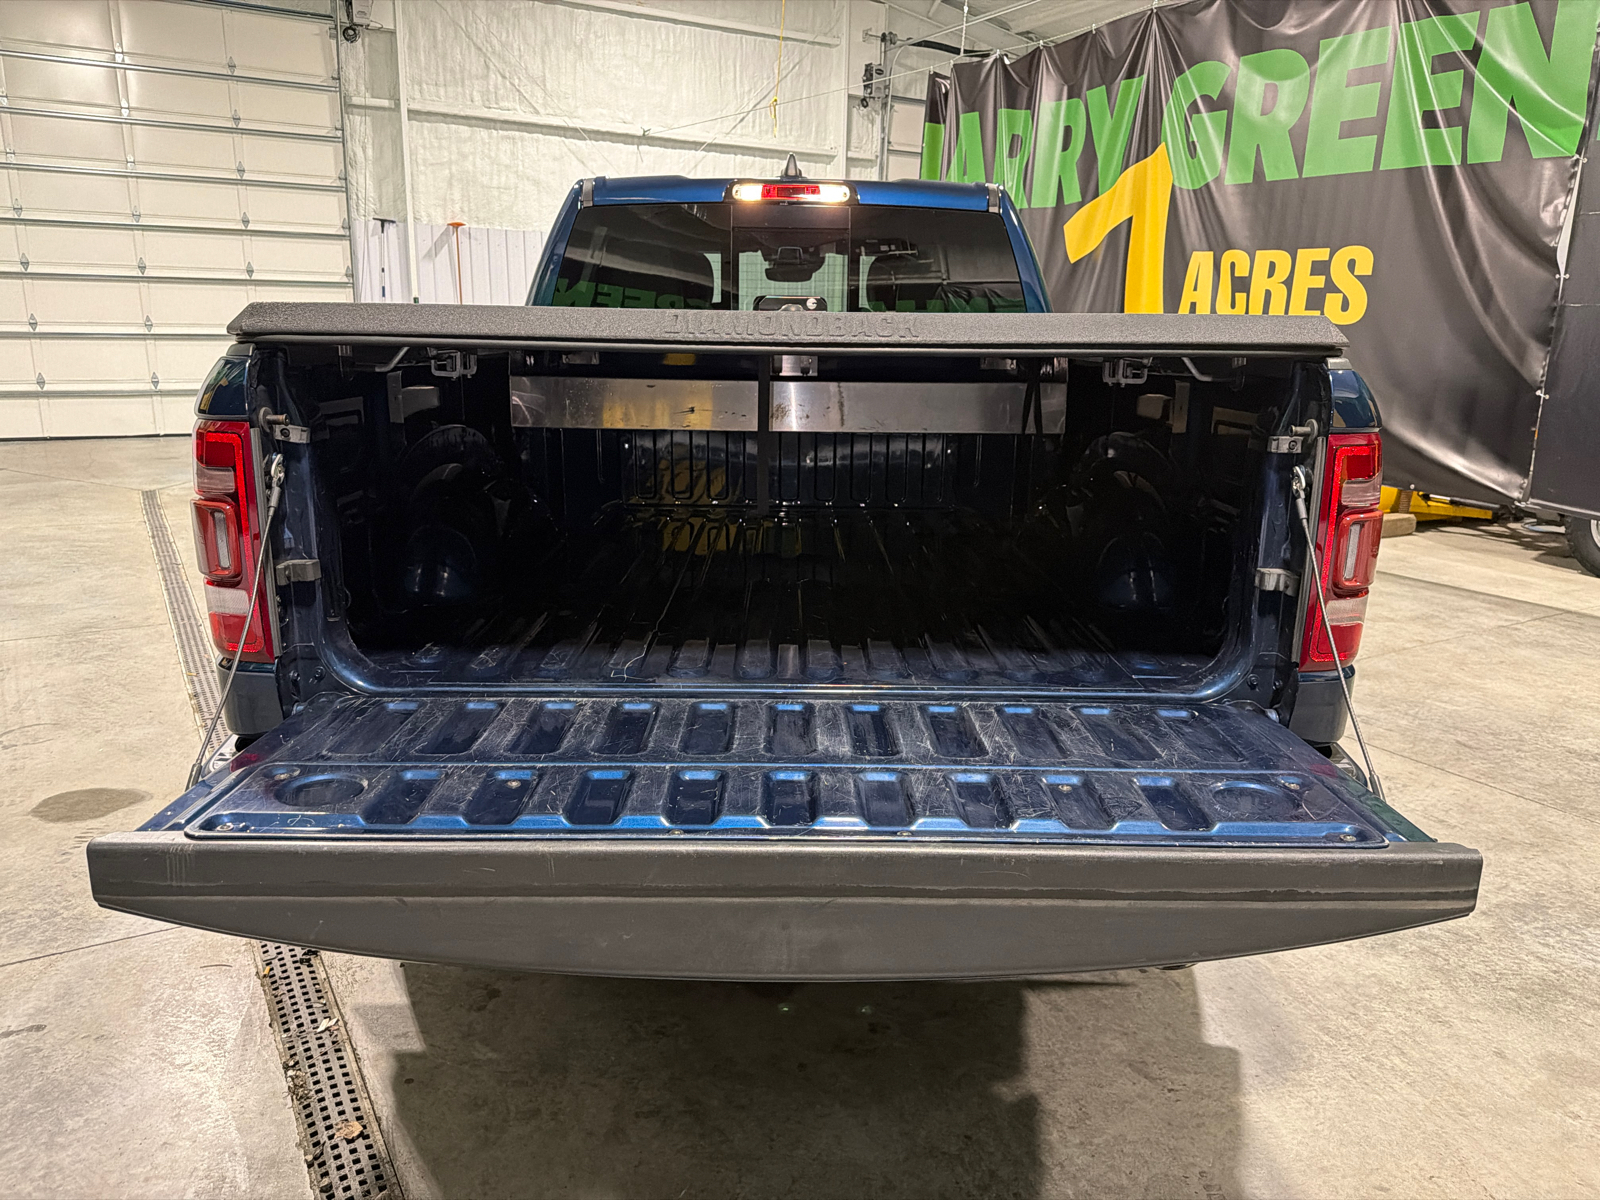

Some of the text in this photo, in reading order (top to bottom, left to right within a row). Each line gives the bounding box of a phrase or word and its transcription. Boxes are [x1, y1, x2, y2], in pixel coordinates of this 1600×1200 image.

[1161, 0, 1598, 189] GREEN
[1178, 245, 1374, 325] ACRES
[665, 313, 920, 338] DIAMONDBACK
